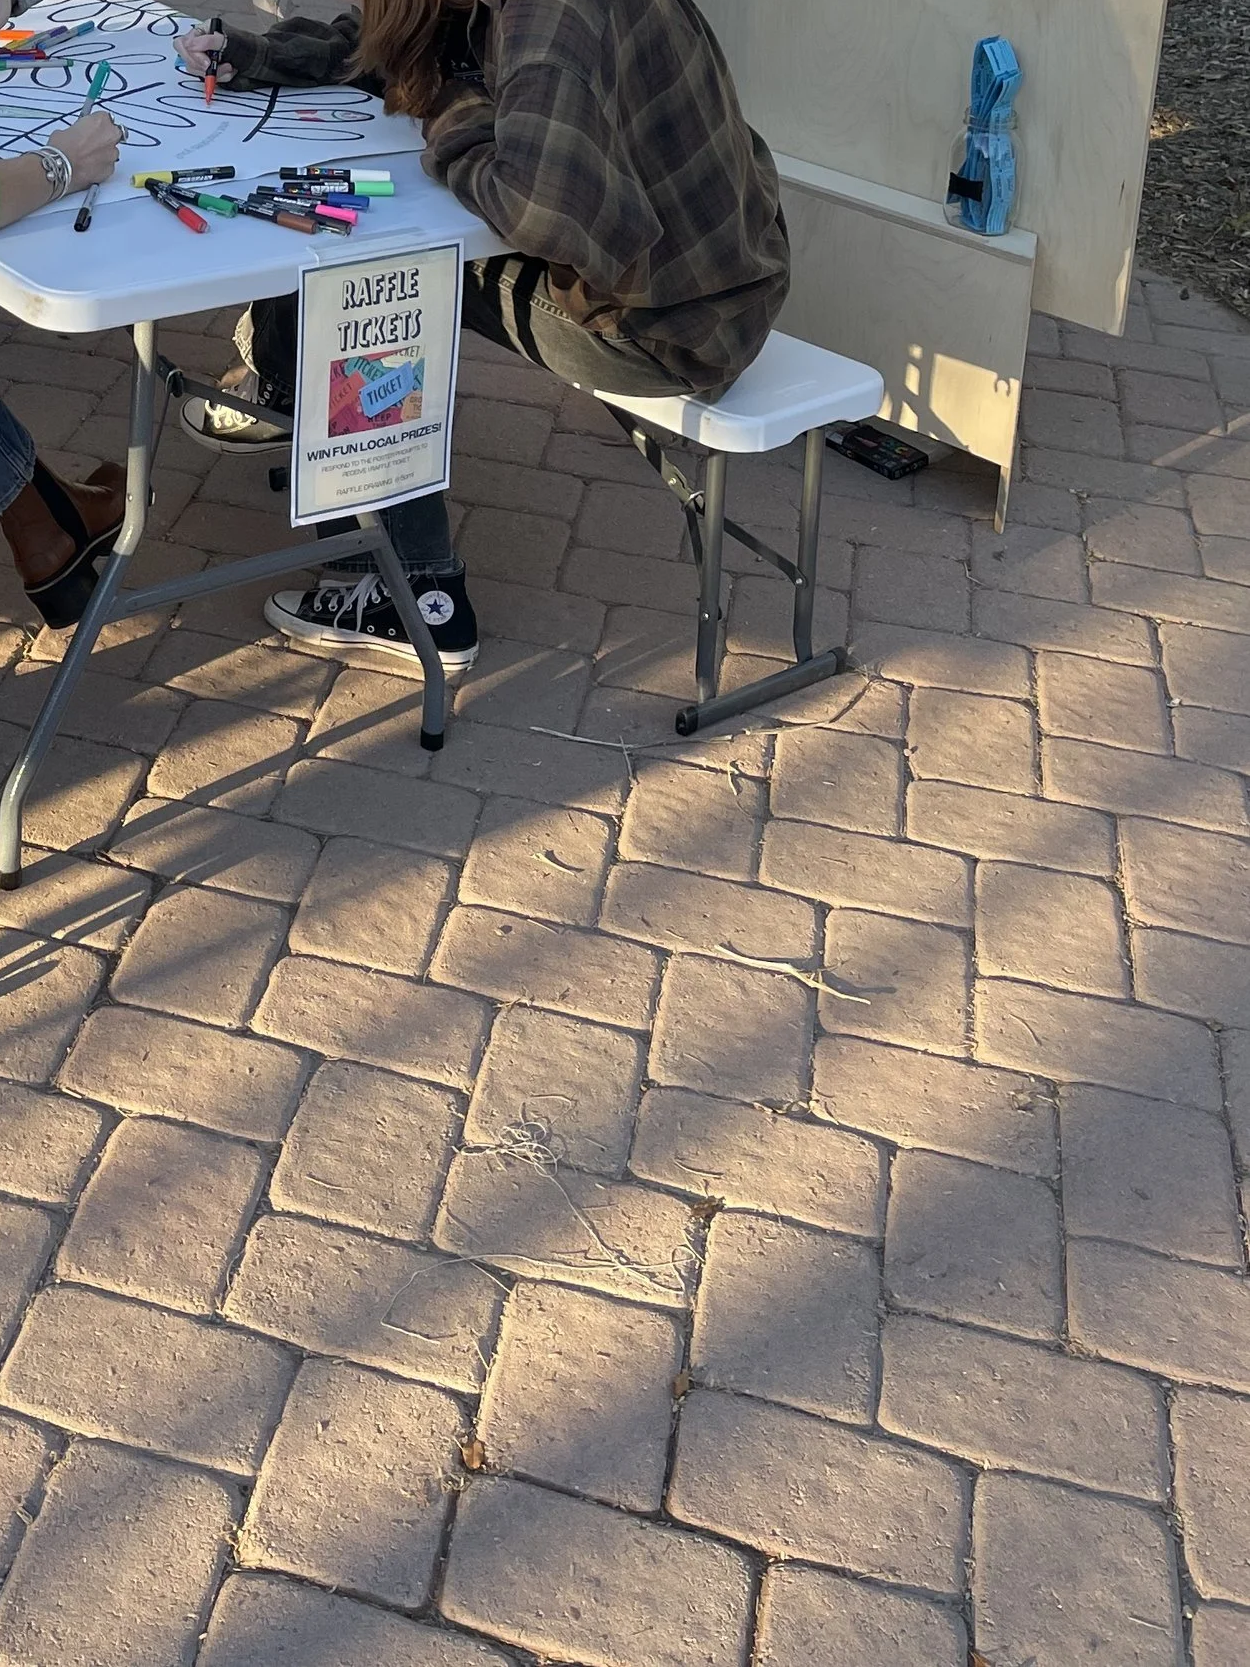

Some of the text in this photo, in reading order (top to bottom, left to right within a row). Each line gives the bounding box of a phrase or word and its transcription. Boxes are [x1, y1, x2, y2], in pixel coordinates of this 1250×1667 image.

[342, 268, 419, 310] RAFFLE
[337, 309, 422, 351] TICKETS
[366, 375, 403, 406] TICKET
[307, 422, 442, 461] WIN FUN LOCAL PRIZES!
[336, 485, 362, 496] RAFFLE
